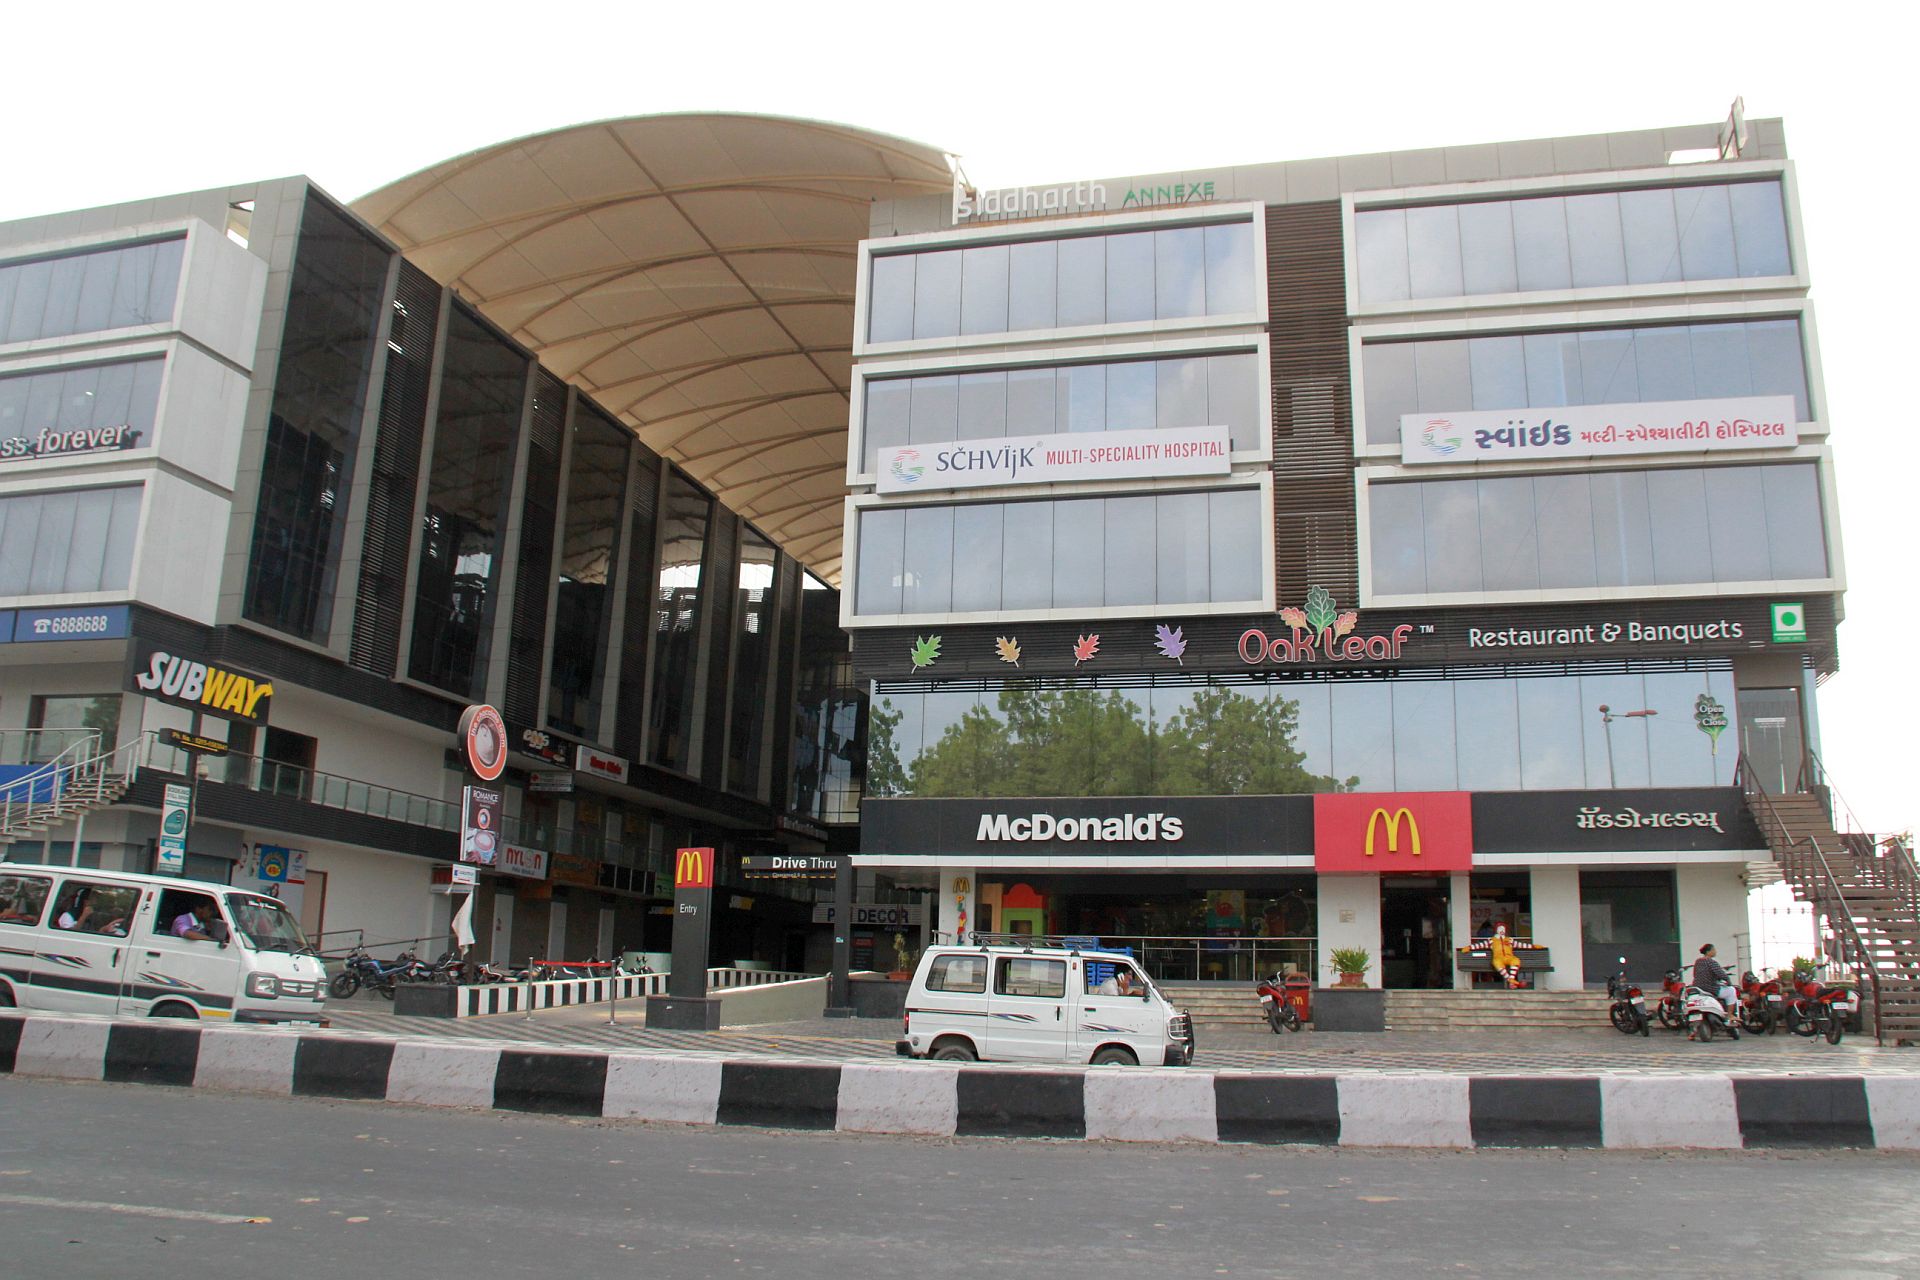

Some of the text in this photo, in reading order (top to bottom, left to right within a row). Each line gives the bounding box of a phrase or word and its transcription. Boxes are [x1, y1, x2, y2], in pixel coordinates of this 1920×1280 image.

[1123, 181, 1215, 203] ANNEXE
[37, 424, 128, 453] forever
[1046, 444, 1161, 466] MULTI-SPECIALITY
[1164, 441, 1225, 459] HOSPITAL
[52, 615, 108, 634] 6888688
[1469, 620, 1743, 648] Restaurant & Banquets
[1238, 627, 1316, 664] Oak
[136, 652, 274, 718] SUBWAY
[1699, 704, 1725, 714] Open
[1702, 717, 1727, 727] Close
[473, 790, 499, 802] ROMANCE
[976, 813, 1184, 842] McDonald's
[772, 857, 807, 869] Drive
[809, 857, 837, 869] Thru
[679, 904, 697, 915] Entry
